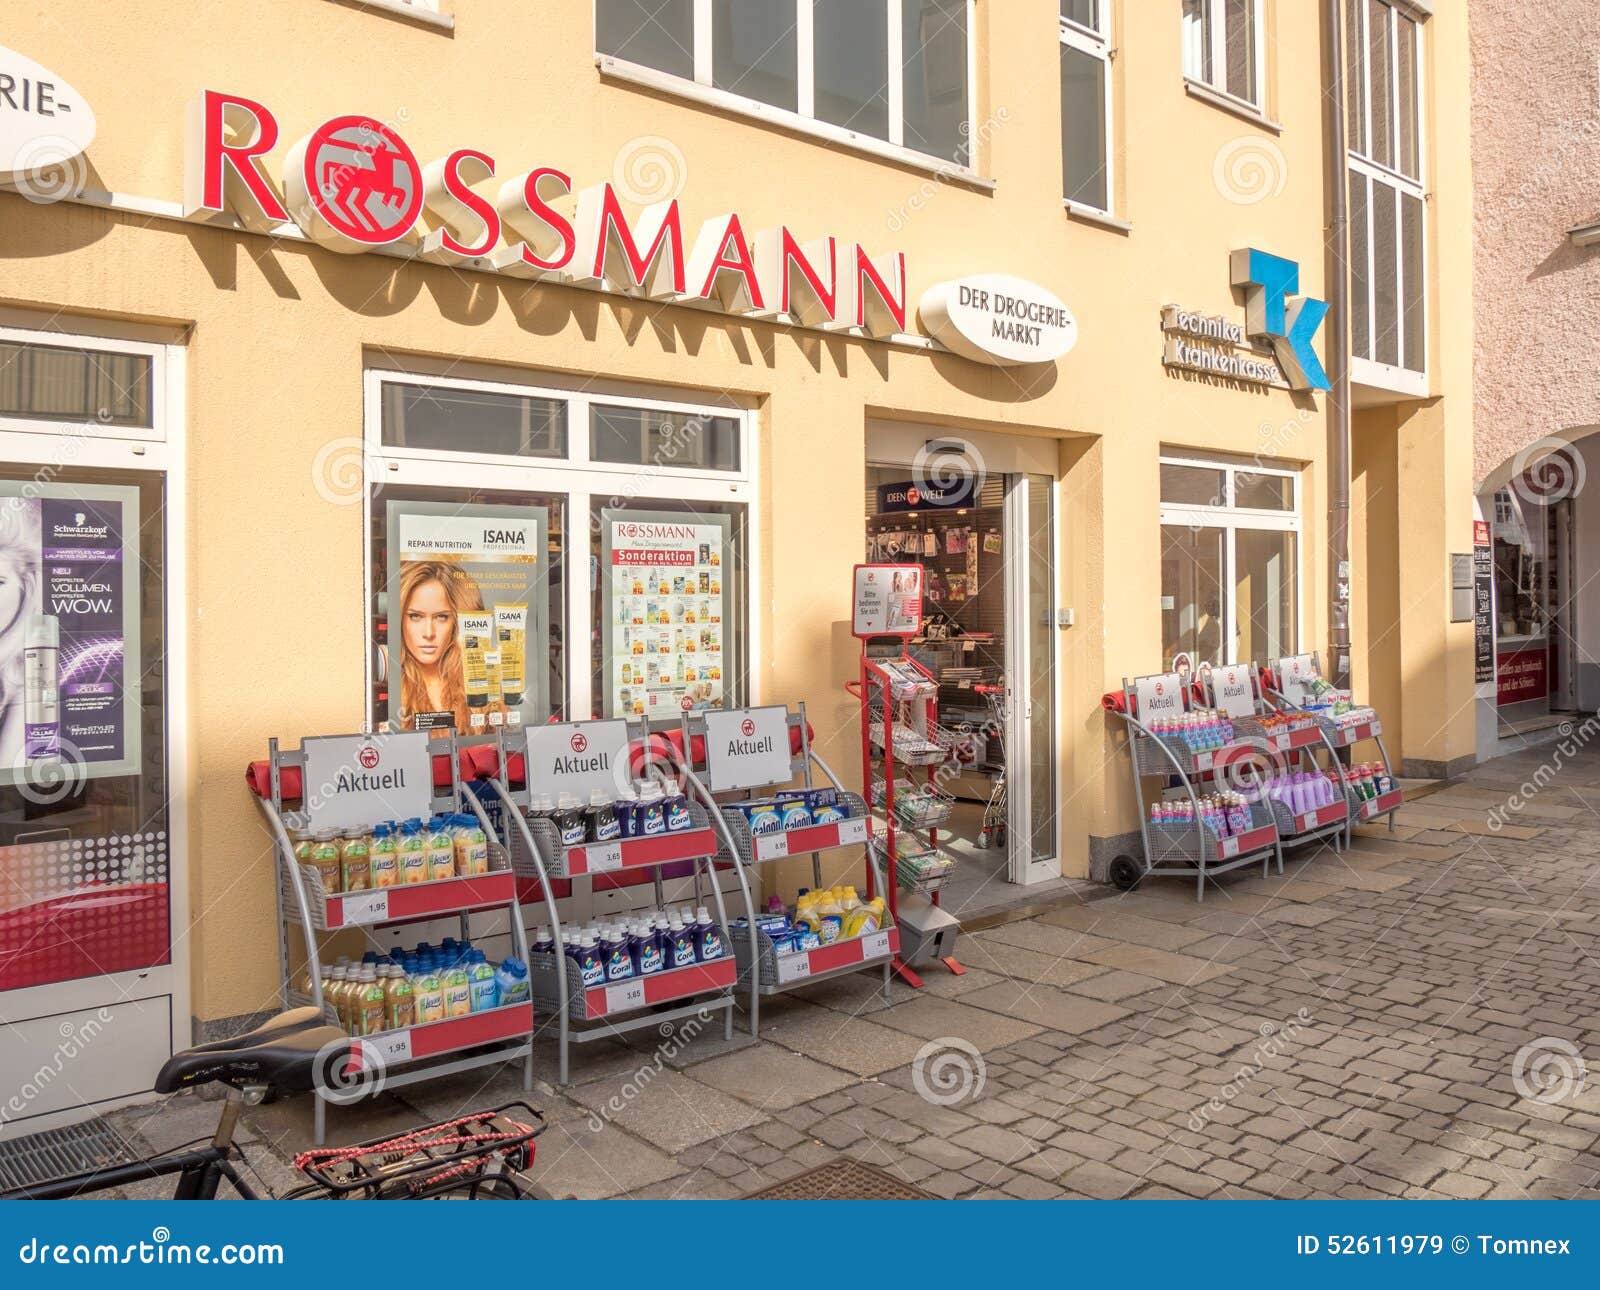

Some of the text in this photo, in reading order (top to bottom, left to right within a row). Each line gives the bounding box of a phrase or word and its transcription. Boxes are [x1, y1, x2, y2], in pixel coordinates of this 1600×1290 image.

[201, 89, 906, 332] ROSSMANN
[959, 285, 1071, 328] DER DROGERIE-
[1167, 304, 1244, 344] Techniker
[1248, 248, 1331, 391] TK
[992, 318, 1041, 346] MARKT
[1174, 338, 1280, 382] Krankenkasse
[887, 489, 944, 503] IDEEN WELT
[54, 525, 107, 535] Schwarzkopf
[483, 530, 525, 544] ISANA
[618, 524, 695, 540] ROSSMANN
[408, 540, 472, 549] REPAIR NUTRITION
[618, 550, 692, 561] Sonderaktion
[51, 584, 112, 592] VOLUMEN.
[51, 599, 113, 614] WOW.
[499, 612, 521, 620] ISANA
[464, 620, 488, 629] ISANA
[1224, 685, 1245, 698] Aktuell
[1149, 696, 1175, 710] Aktuell
[728, 736, 773, 757] Aktuell
[553, 753, 609, 775] Aktuell
[336, 768, 406, 793] Aktuell
[670, 815, 689, 826] Coral
[583, 967, 603, 980] Coral
[611, 962, 631, 974] Coral
